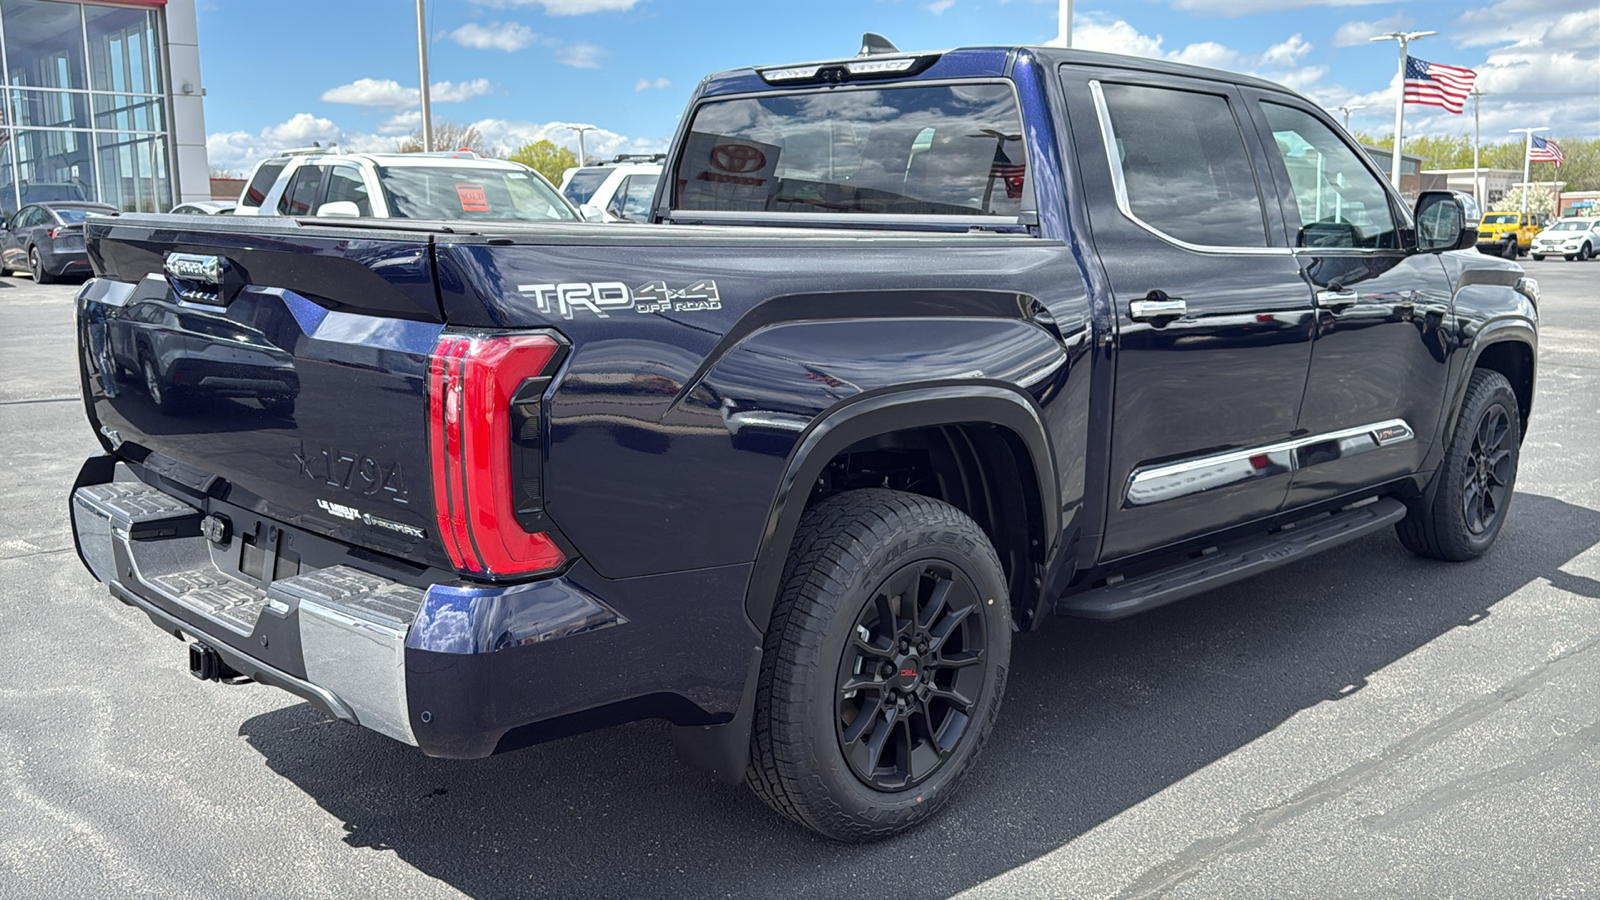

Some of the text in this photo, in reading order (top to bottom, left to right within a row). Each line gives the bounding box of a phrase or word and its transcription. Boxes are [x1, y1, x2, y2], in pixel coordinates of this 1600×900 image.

[517, 281, 634, 320] TRD
[634, 301, 722, 314] OFF ROAD
[321, 447, 409, 504] 1794
